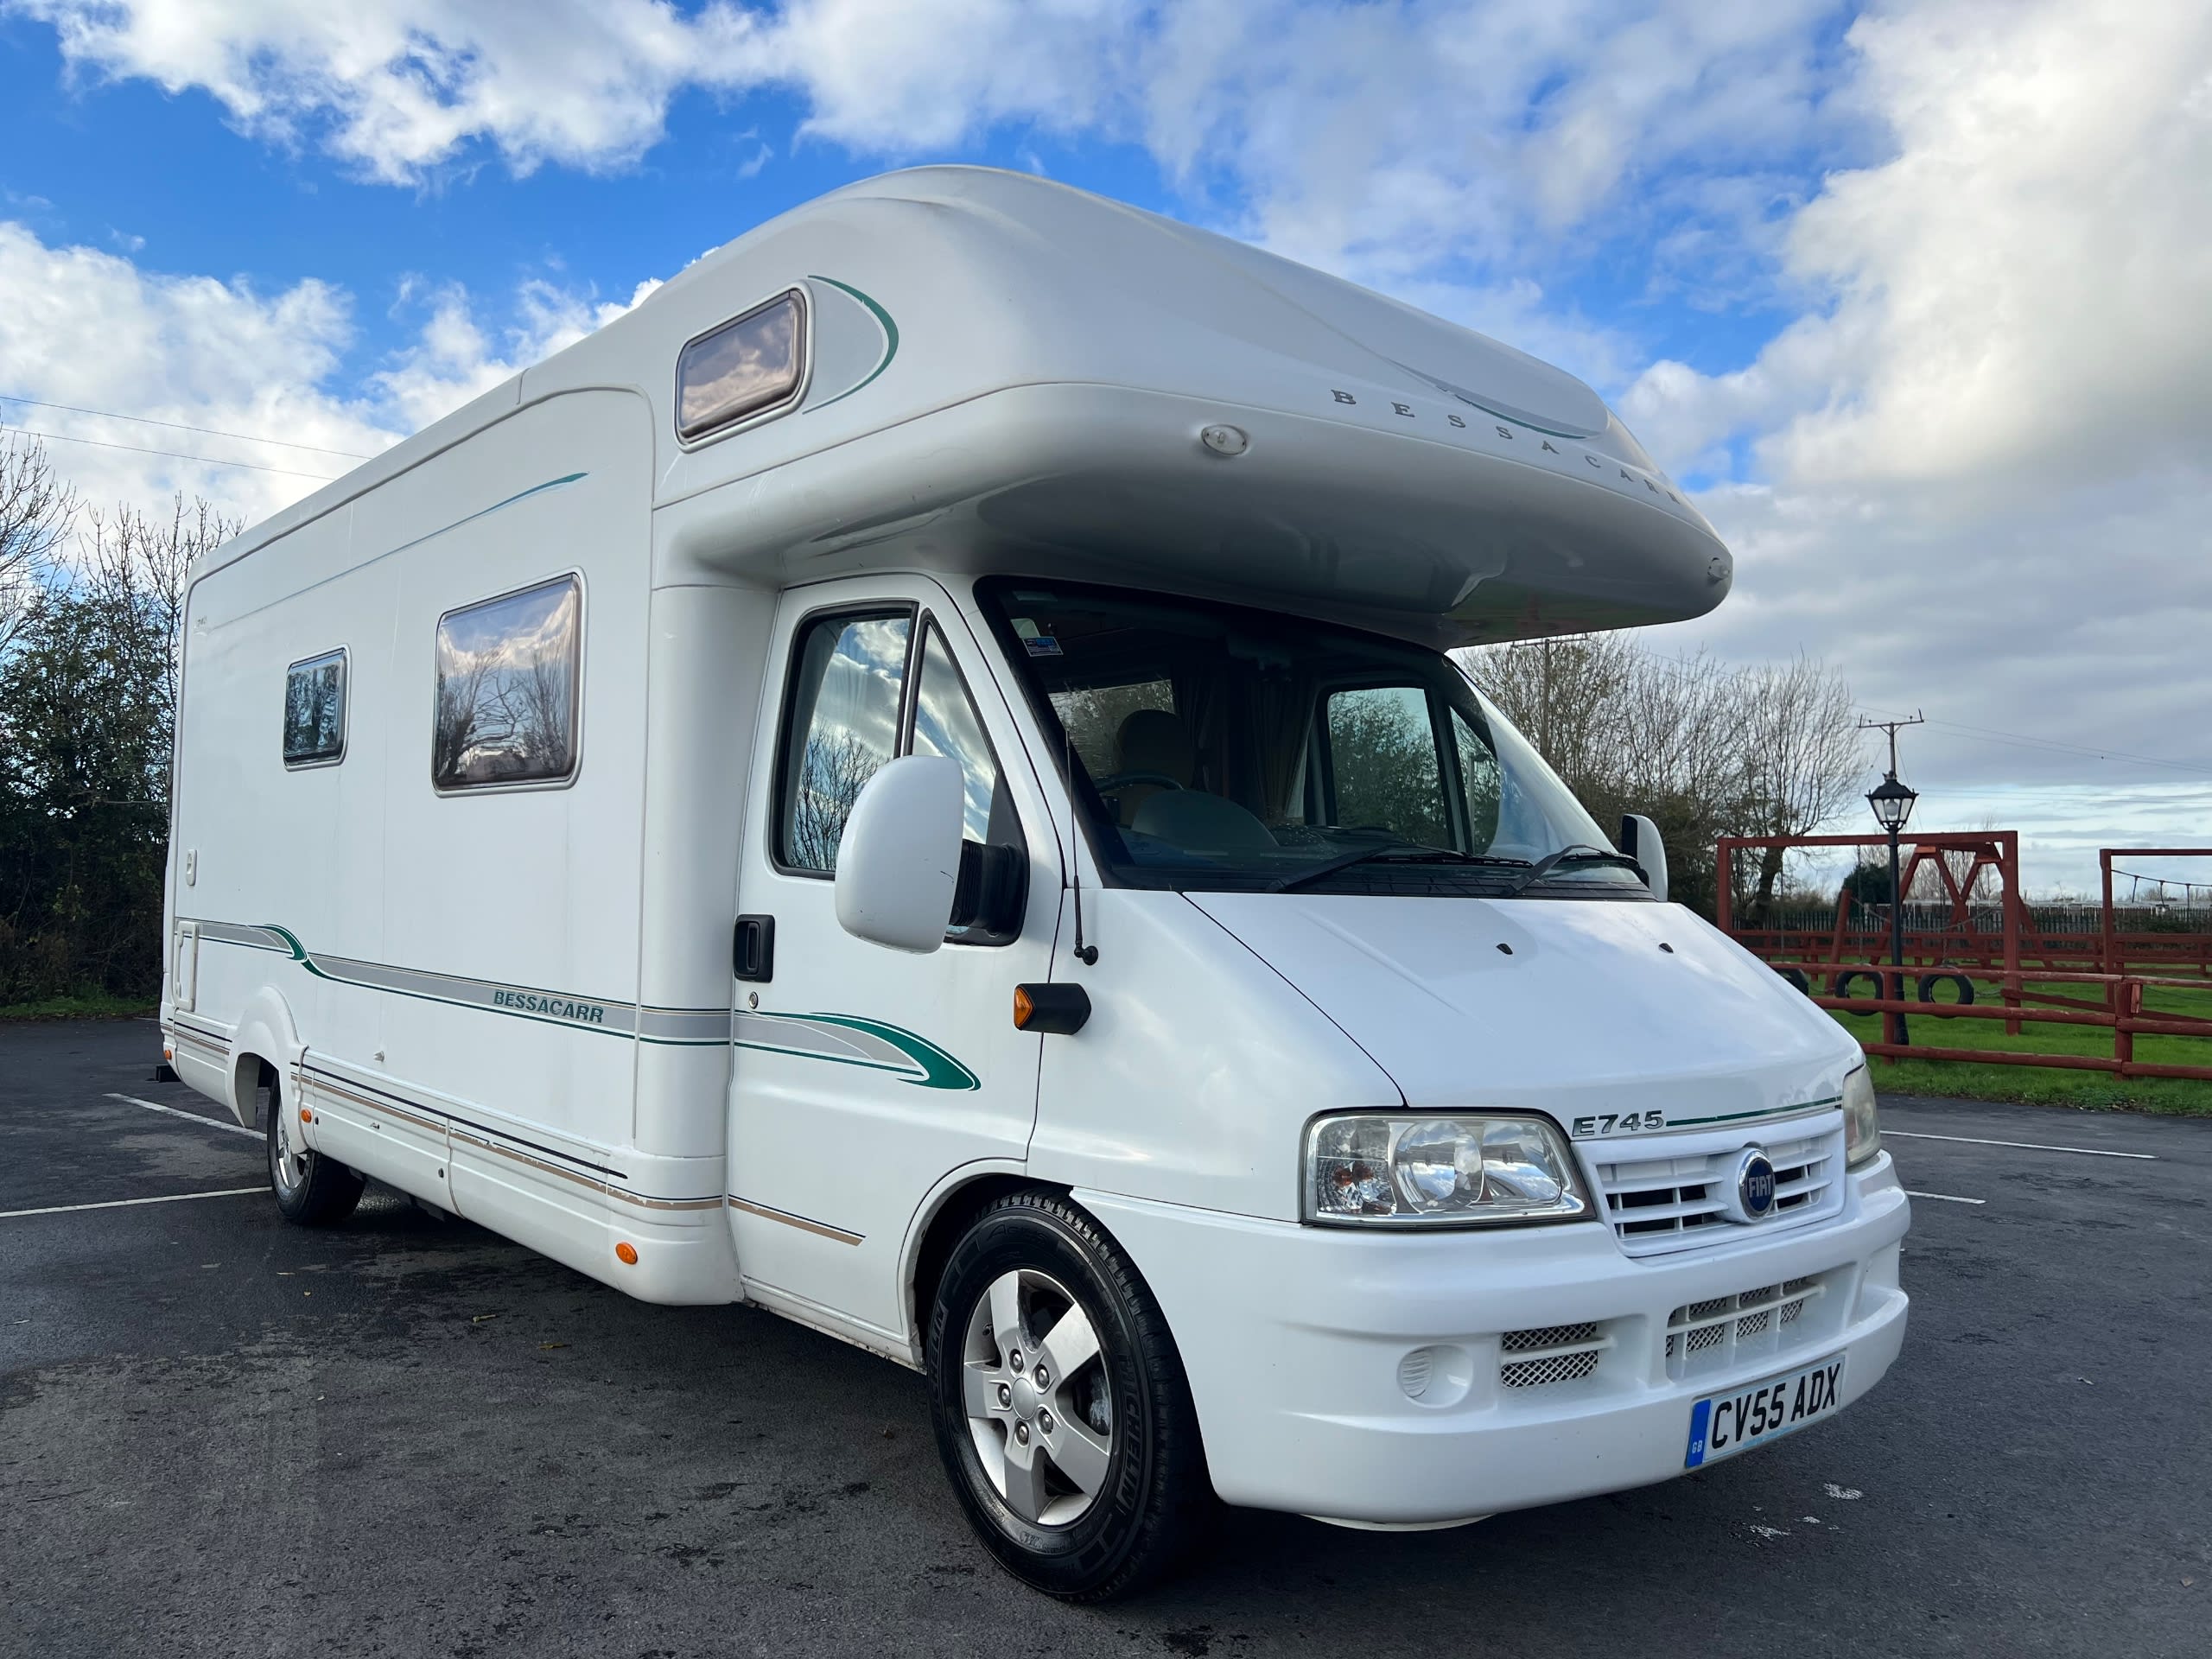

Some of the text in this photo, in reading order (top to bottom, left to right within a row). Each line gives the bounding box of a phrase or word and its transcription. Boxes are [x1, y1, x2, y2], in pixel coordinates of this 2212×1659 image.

[1331, 388, 1681, 505] BESSACARR
[493, 989, 604, 1023] BESSACARR
[1572, 1109, 1664, 1137] E745
[1748, 1173, 1773, 1198] FIAT
[1712, 1363, 1840, 1449] CV55 ADX
[1691, 1440, 1703, 1454] GB
